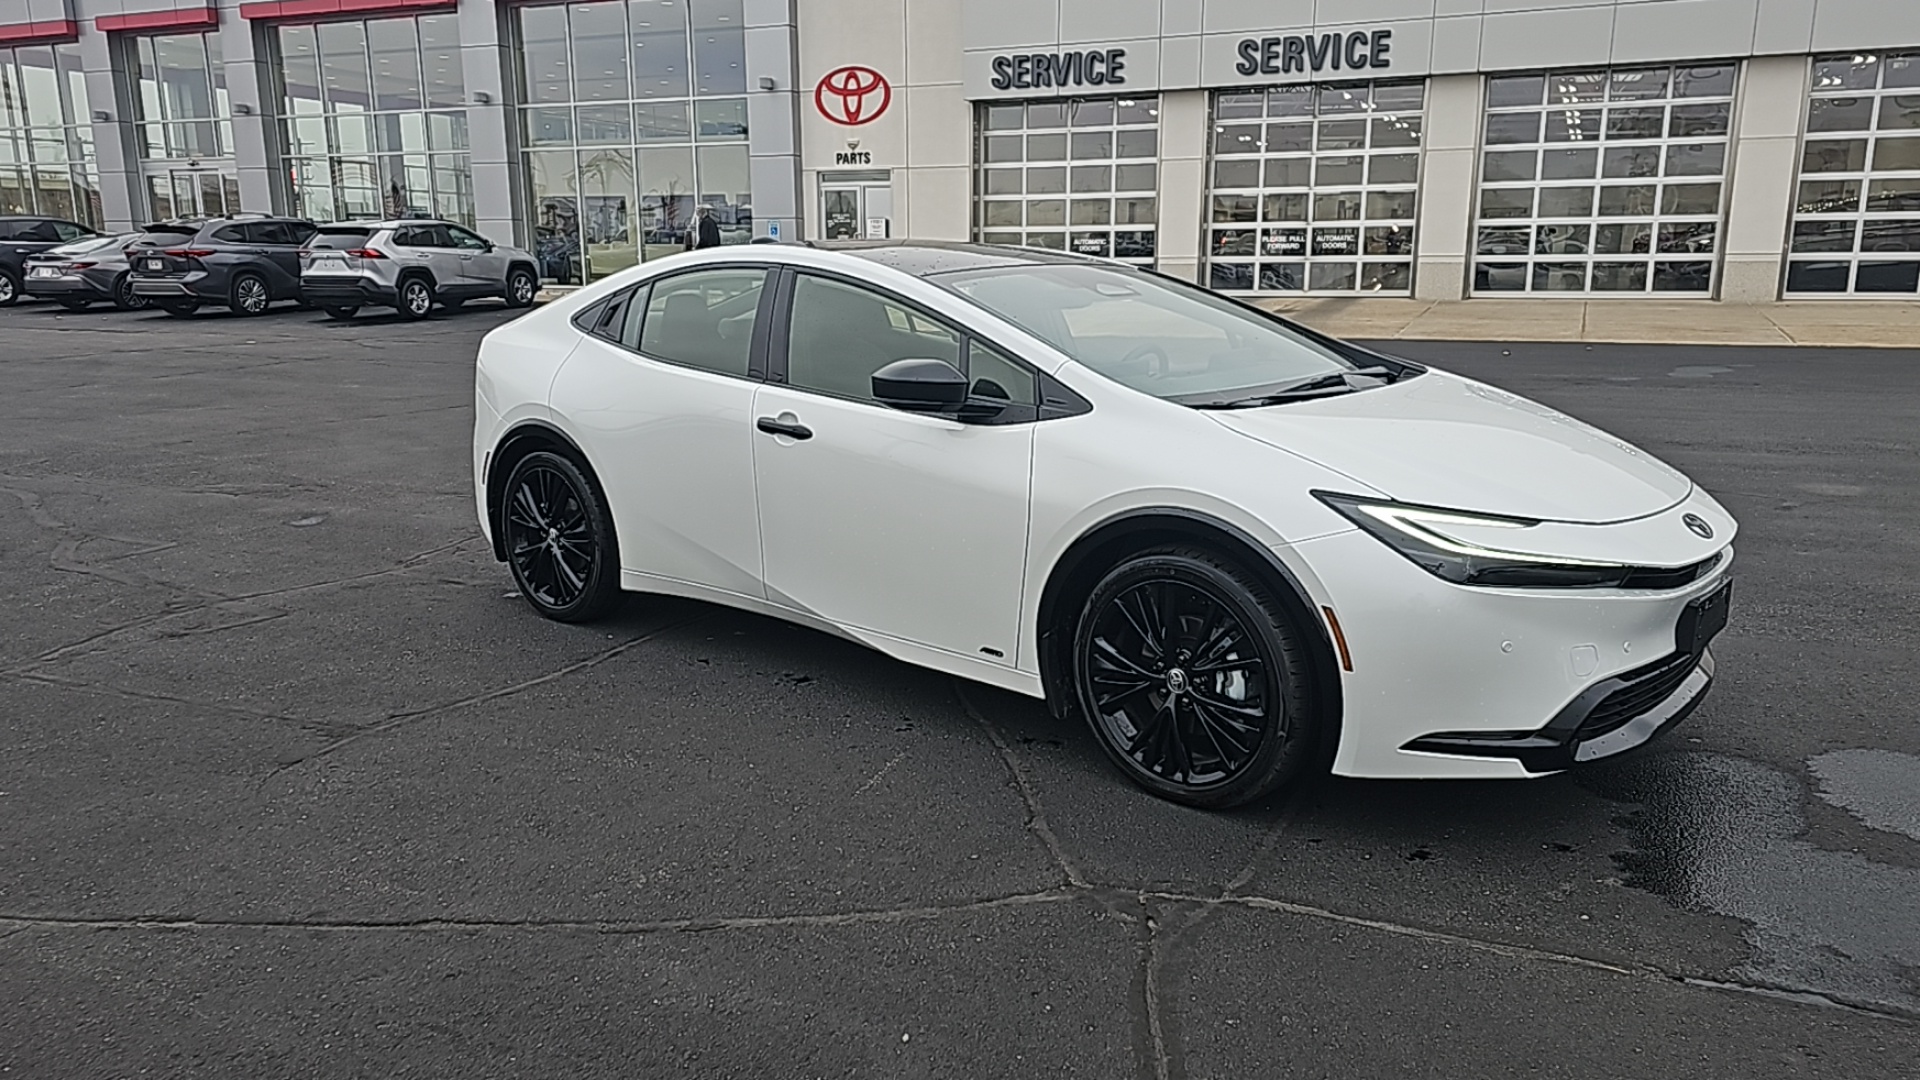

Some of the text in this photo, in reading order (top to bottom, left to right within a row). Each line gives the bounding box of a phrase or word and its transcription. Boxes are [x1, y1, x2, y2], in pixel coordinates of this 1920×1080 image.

[991, 49, 1127, 90] SERVICE
[1236, 30, 1392, 76] SERVICE
[836, 152, 871, 165] PARTS
